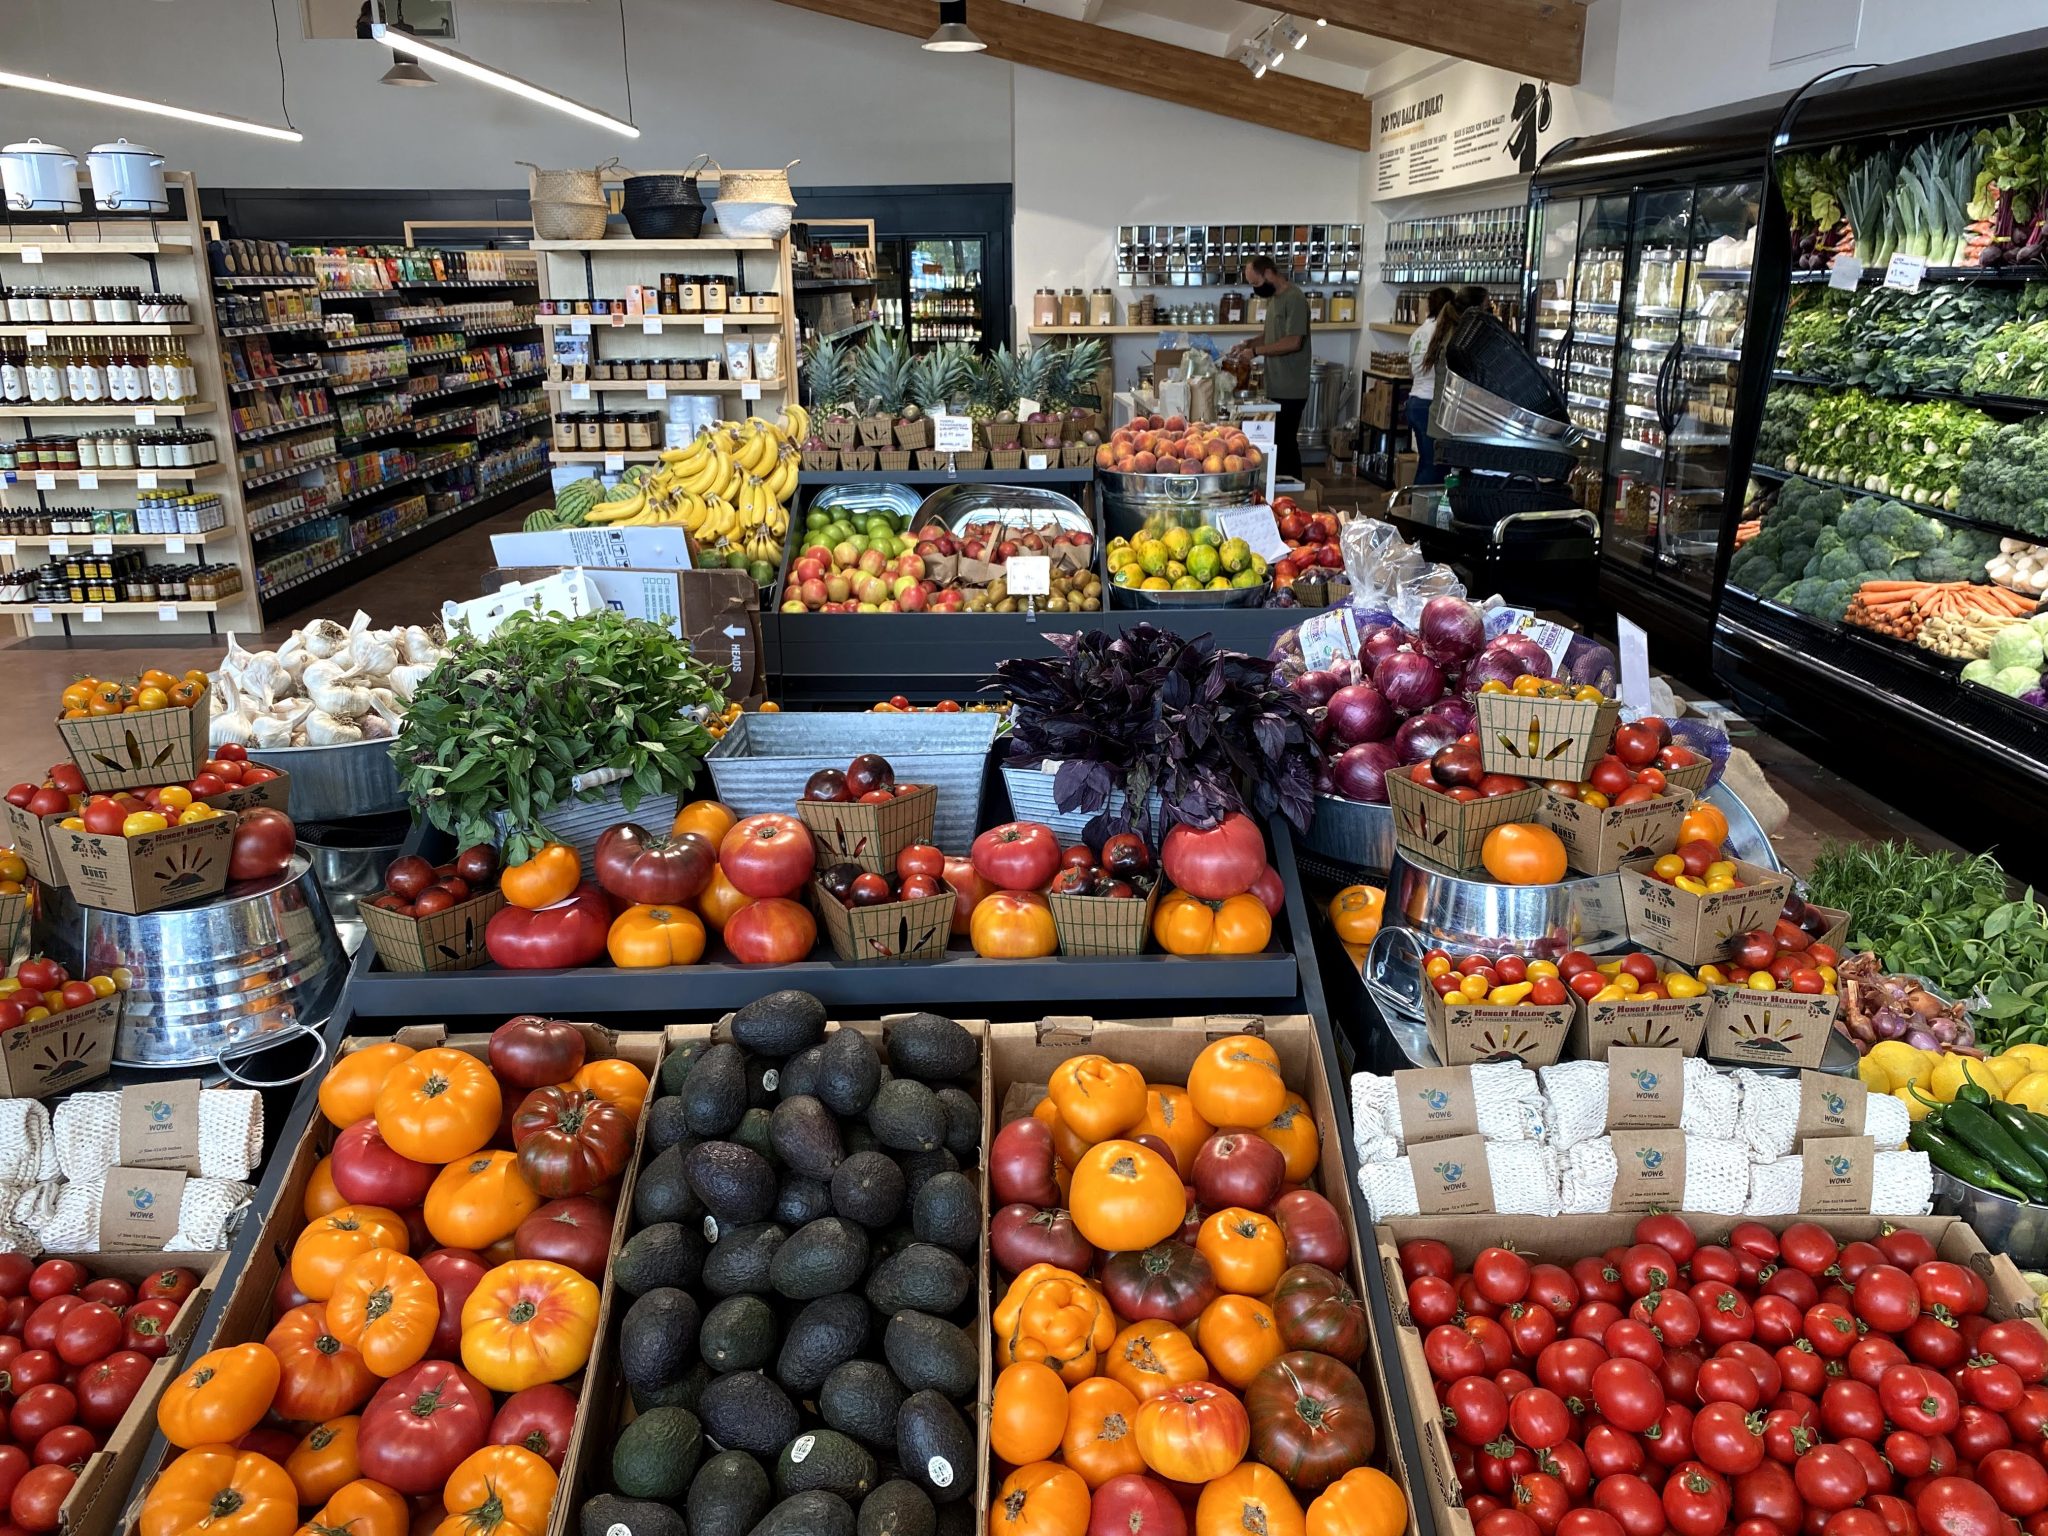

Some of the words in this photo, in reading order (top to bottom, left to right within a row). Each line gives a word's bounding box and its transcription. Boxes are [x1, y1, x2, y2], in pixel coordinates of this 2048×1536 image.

[1380, 115, 1390, 134] DO
[1390, 110, 1401, 130] YOU
[1401, 104, 1416, 126] BALK
[1416, 101, 1424, 120] AT
[1424, 93, 1443, 118] BULK?
[731, 644, 742, 672] HEADS
[1624, 807, 1649, 816] HUNGRY
[1650, 800, 1673, 810] HOLLOW
[156, 831, 186, 842] HUNGRY
[187, 823, 215, 834] HOLLOW
[1551, 822, 1576, 841] DURST
[81, 864, 107, 879] DURST
[1722, 892, 1747, 902] HUNGRY
[1748, 888, 1772, 896] HOLLOW
[1645, 908, 1671, 928] DURST
[1771, 996, 1807, 1004] HOLLOW
[31, 1020, 64, 1033] HUNGRY
[66, 1008, 97, 1022] HOLLOW
